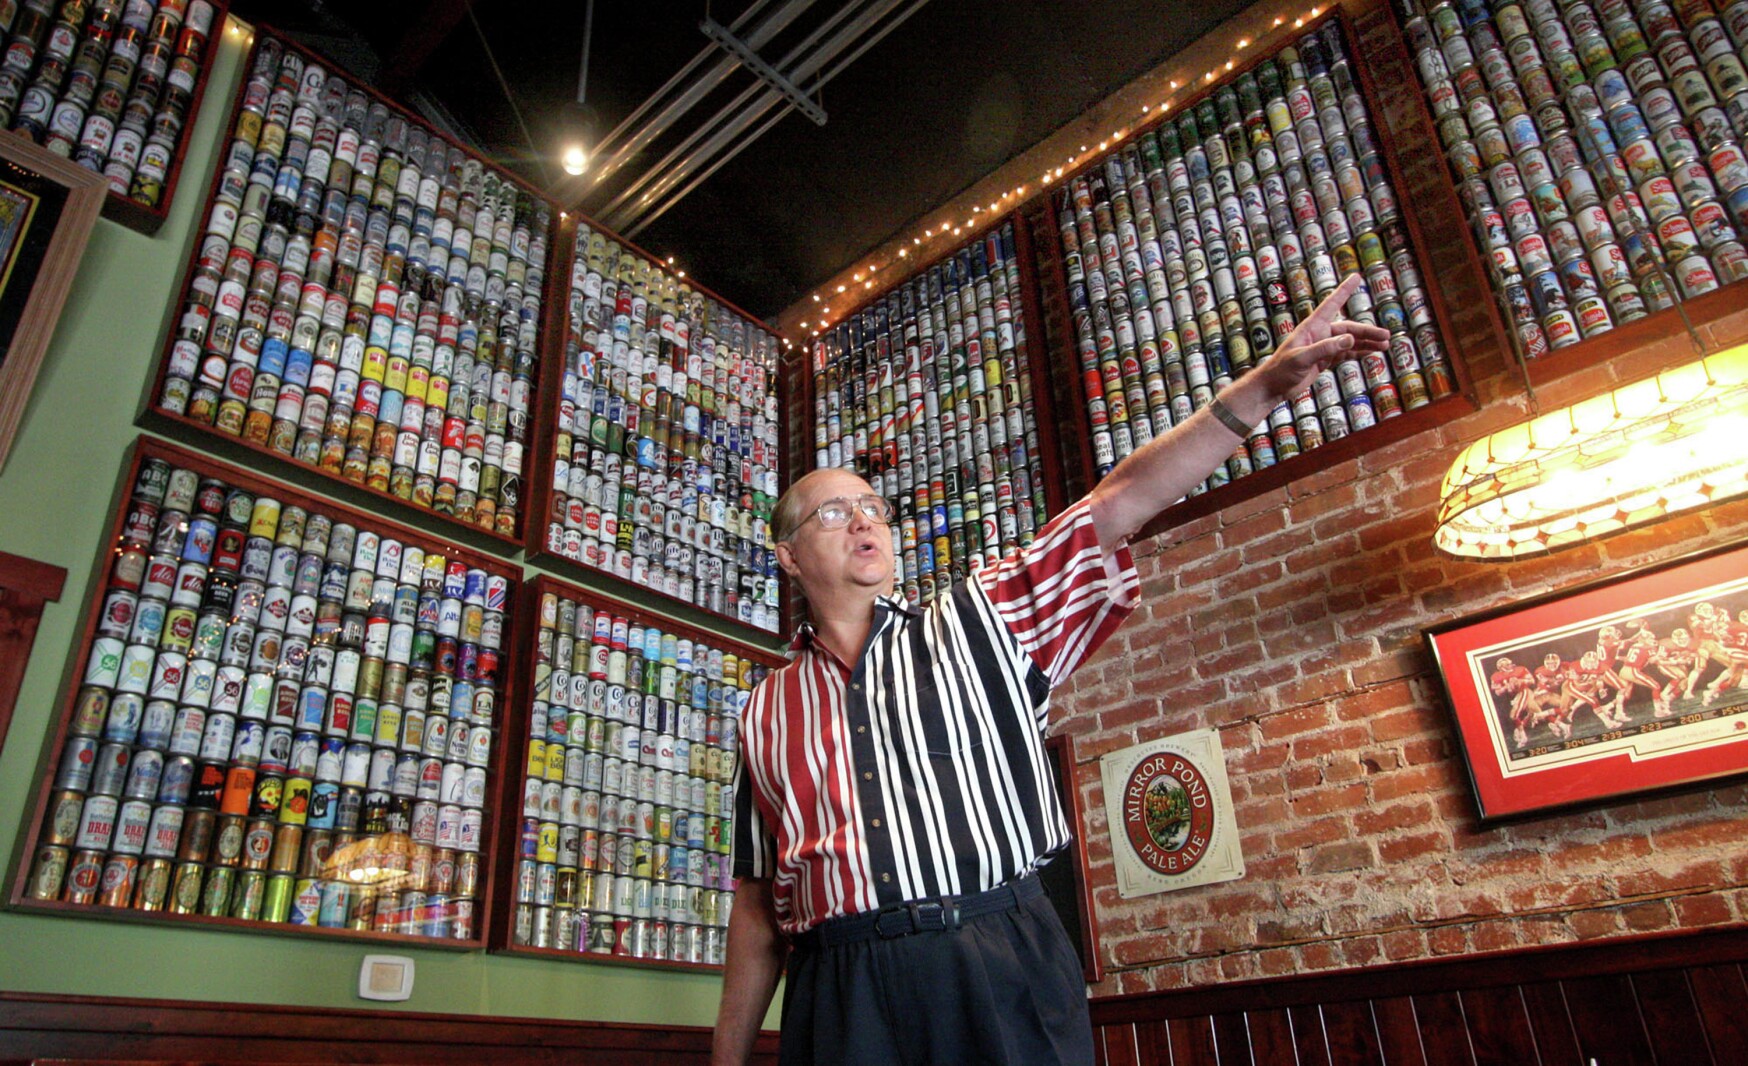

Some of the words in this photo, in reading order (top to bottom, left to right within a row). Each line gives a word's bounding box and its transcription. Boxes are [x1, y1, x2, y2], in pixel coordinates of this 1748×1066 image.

[129, 511, 157, 528] ABC
[165, 671, 179, 683] 56
[225, 684, 238, 695] 56
[1601, 730, 1623, 741] 2:39
[1680, 713, 1702, 725] 2:00
[1128, 757, 1167, 823] MIRROR
[1171, 760, 1207, 809] POND
[1141, 843, 1178, 870] PALE
[1180, 834, 1206, 866] ALE
